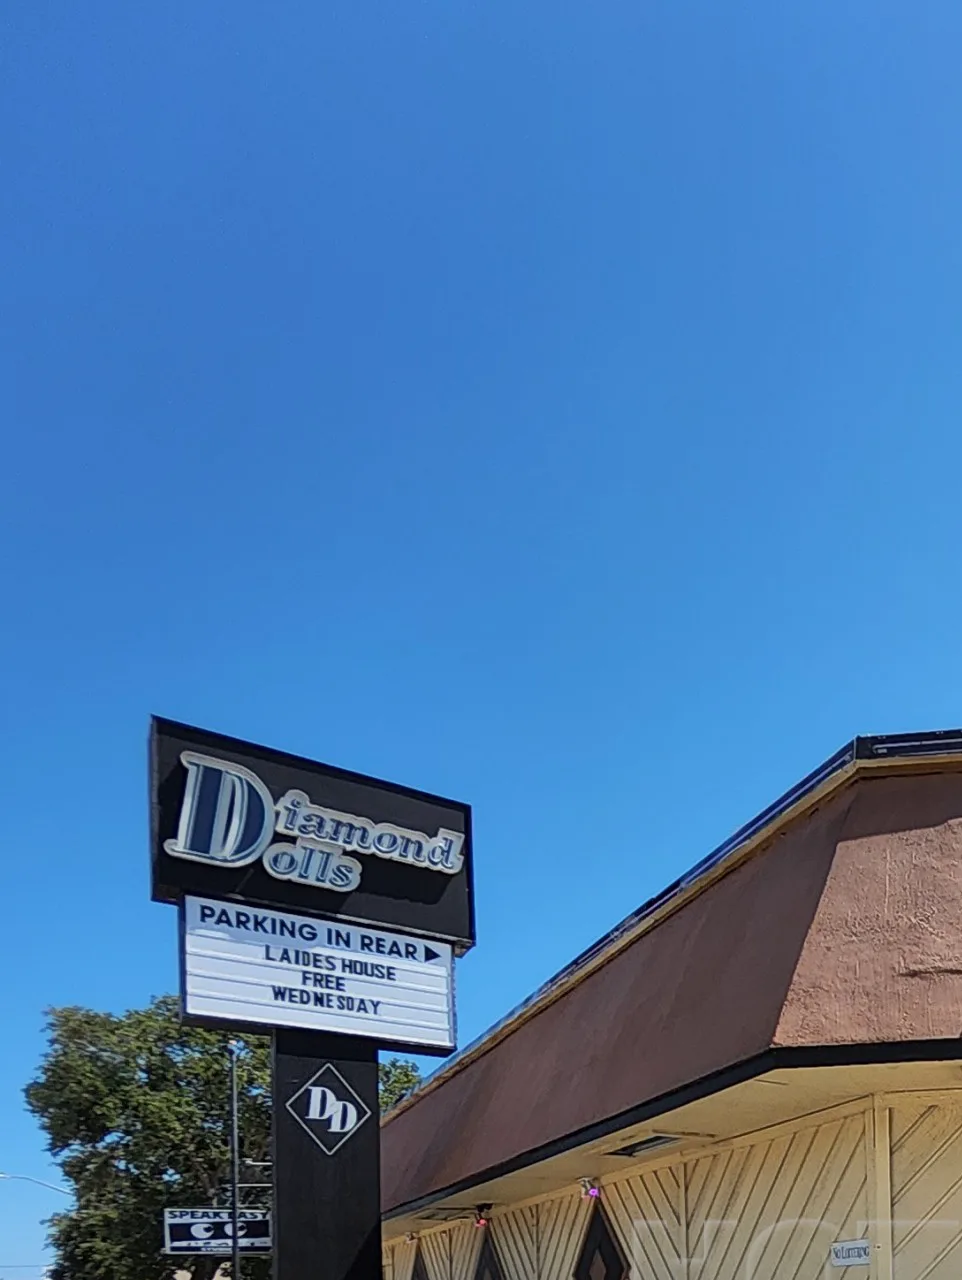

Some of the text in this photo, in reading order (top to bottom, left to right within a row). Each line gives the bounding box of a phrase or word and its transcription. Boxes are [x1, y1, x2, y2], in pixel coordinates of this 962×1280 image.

[165, 752, 464, 874] Diamond
[199, 904, 419, 961] PARKING IN REAR
[265, 945, 398, 981] LAIDES HOUSE
[301, 971, 346, 992] FREE
[272, 985, 382, 1015] WEDNESDAY
[168, 1210, 224, 1220] SPEAK
